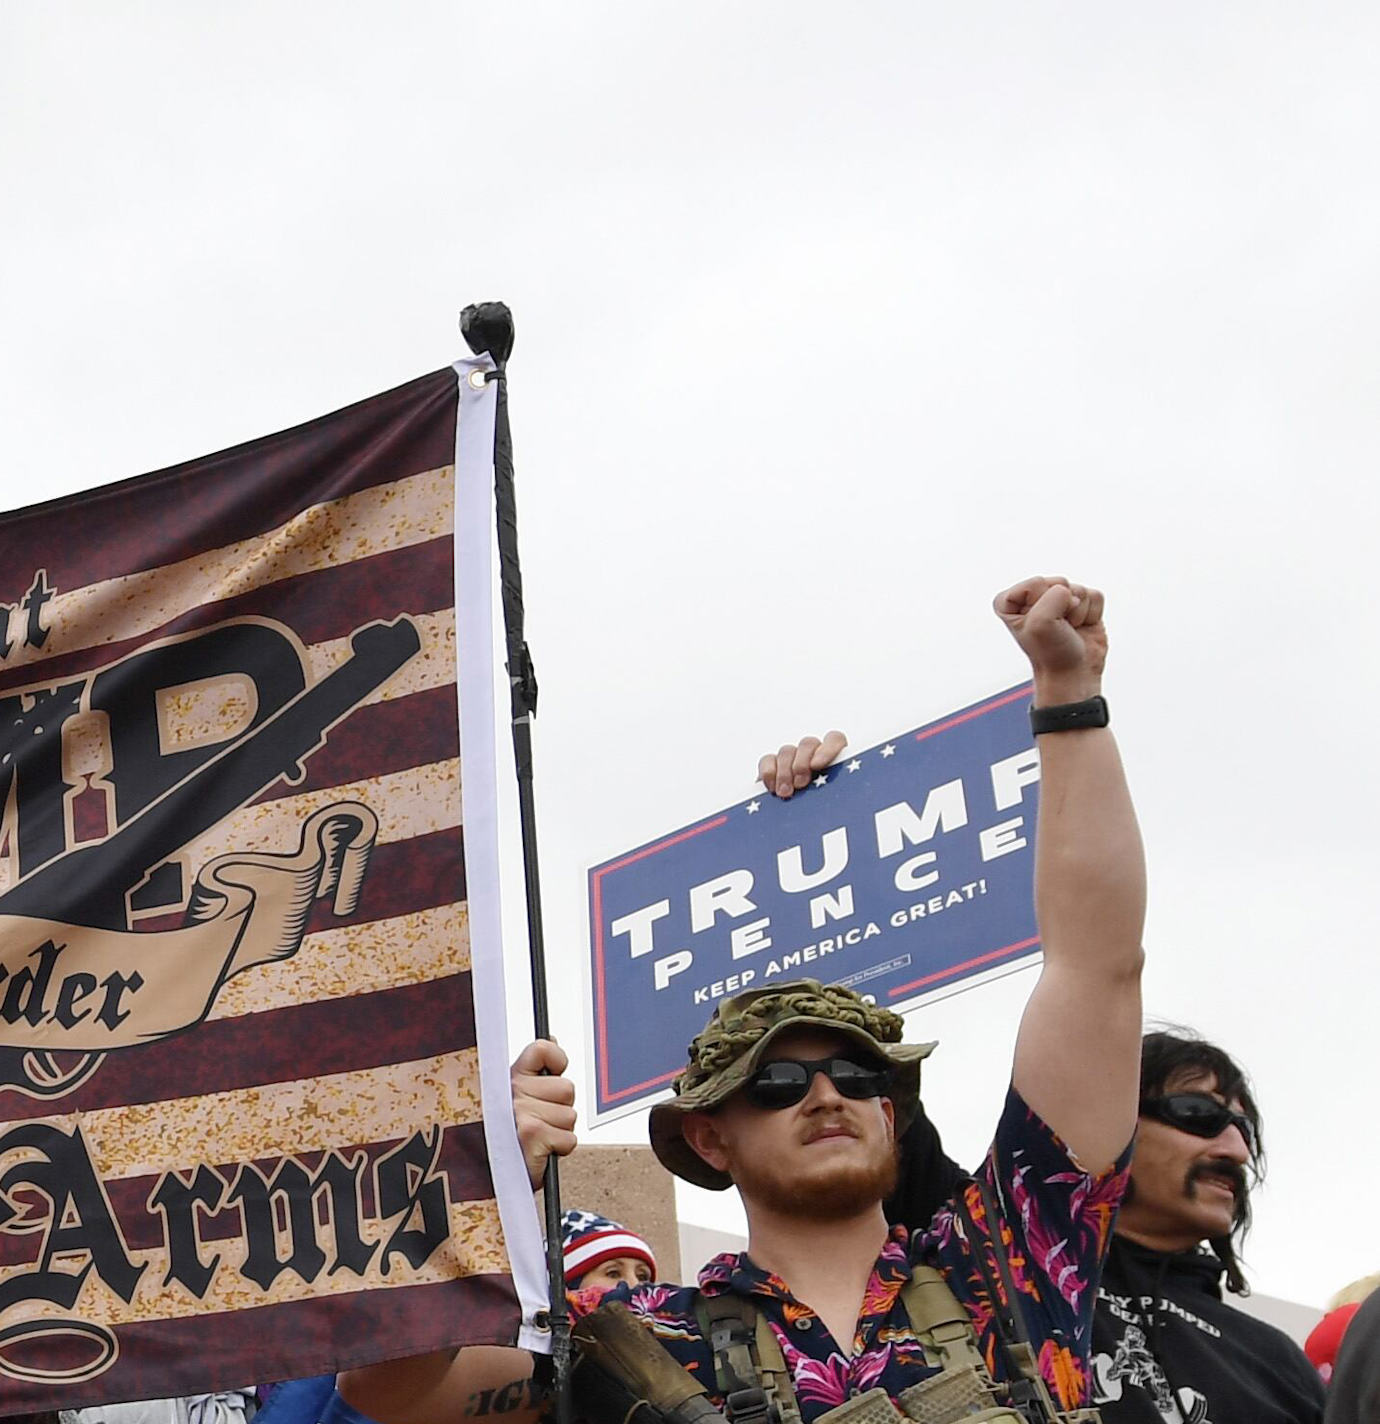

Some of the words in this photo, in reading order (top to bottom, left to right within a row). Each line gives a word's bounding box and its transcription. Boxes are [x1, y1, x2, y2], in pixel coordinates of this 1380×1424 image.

[611, 747, 1041, 959] TRUMP
[653, 816, 1027, 990] PENCE
[693, 969, 758, 1005] KEEP
[764, 921, 881, 978] AMERICA
[890, 879, 987, 928] GREAT!
